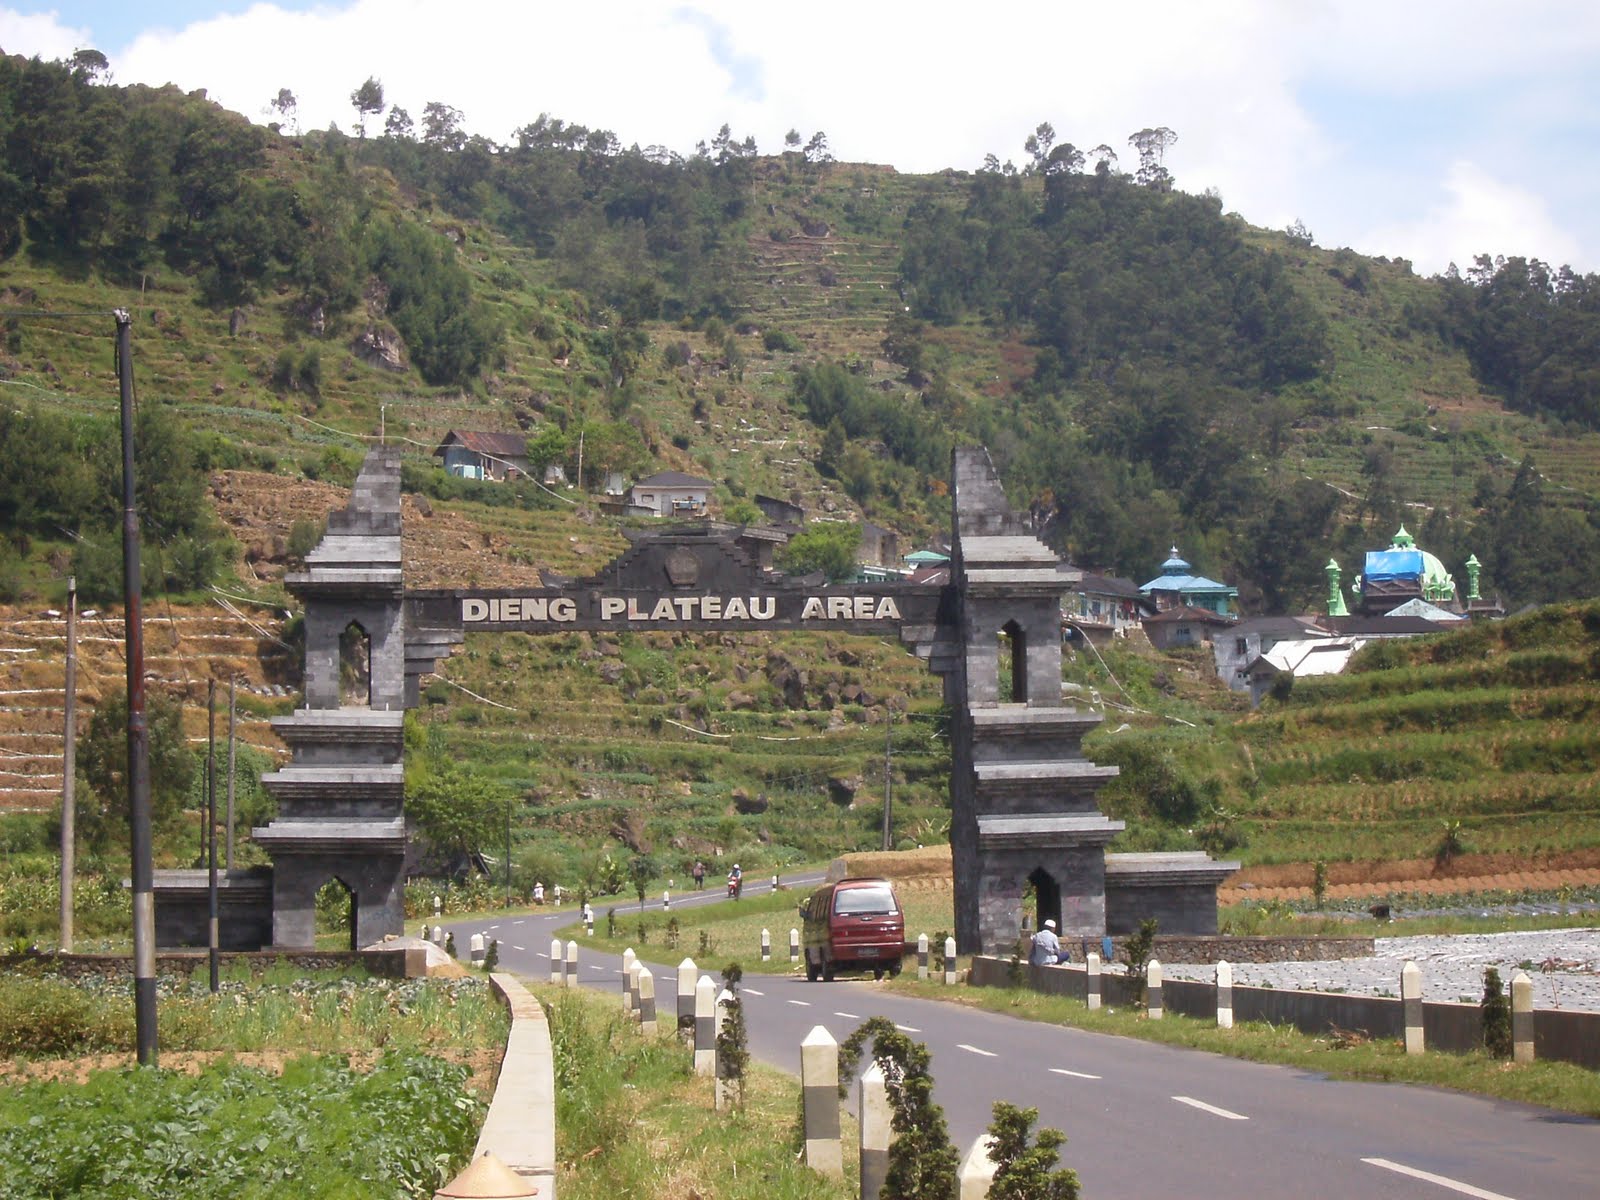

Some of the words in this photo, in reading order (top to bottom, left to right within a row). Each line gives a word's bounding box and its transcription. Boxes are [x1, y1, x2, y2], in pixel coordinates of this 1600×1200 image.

[462, 598, 577, 622] DIENG
[601, 596, 776, 621] PLATEAU
[801, 596, 901, 620] AREA
